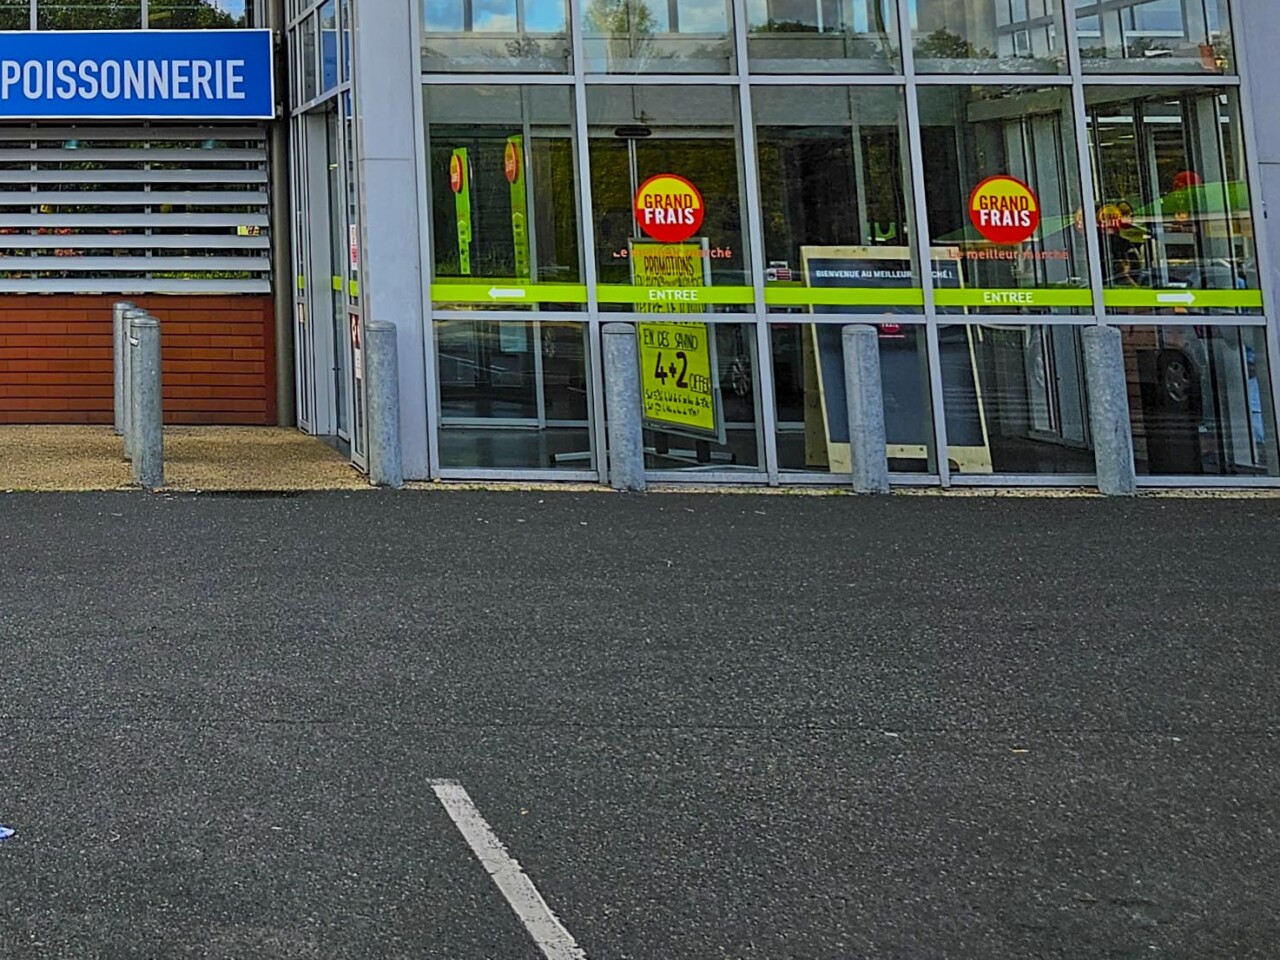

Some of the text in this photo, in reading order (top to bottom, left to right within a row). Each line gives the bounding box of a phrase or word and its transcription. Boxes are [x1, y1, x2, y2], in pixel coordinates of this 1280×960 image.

[0, 59, 246, 101] POISSONNERIE
[644, 194, 693, 208] GRAND
[979, 195, 1029, 211] GRAND
[644, 208, 695, 225] FRAIS
[979, 210, 1031, 227] FRAIS
[966, 248, 1018, 260] meilleur
[1023, 247, 1069, 260] marché
[643, 255, 695, 276] PROMOTIONS
[816, 269, 860, 278] BIENVENUE
[861, 269, 873, 278] AU
[874, 269, 913, 278] MEILLEUR
[649, 290, 698, 301] ENTREE
[984, 292, 1034, 304] ENTREE
